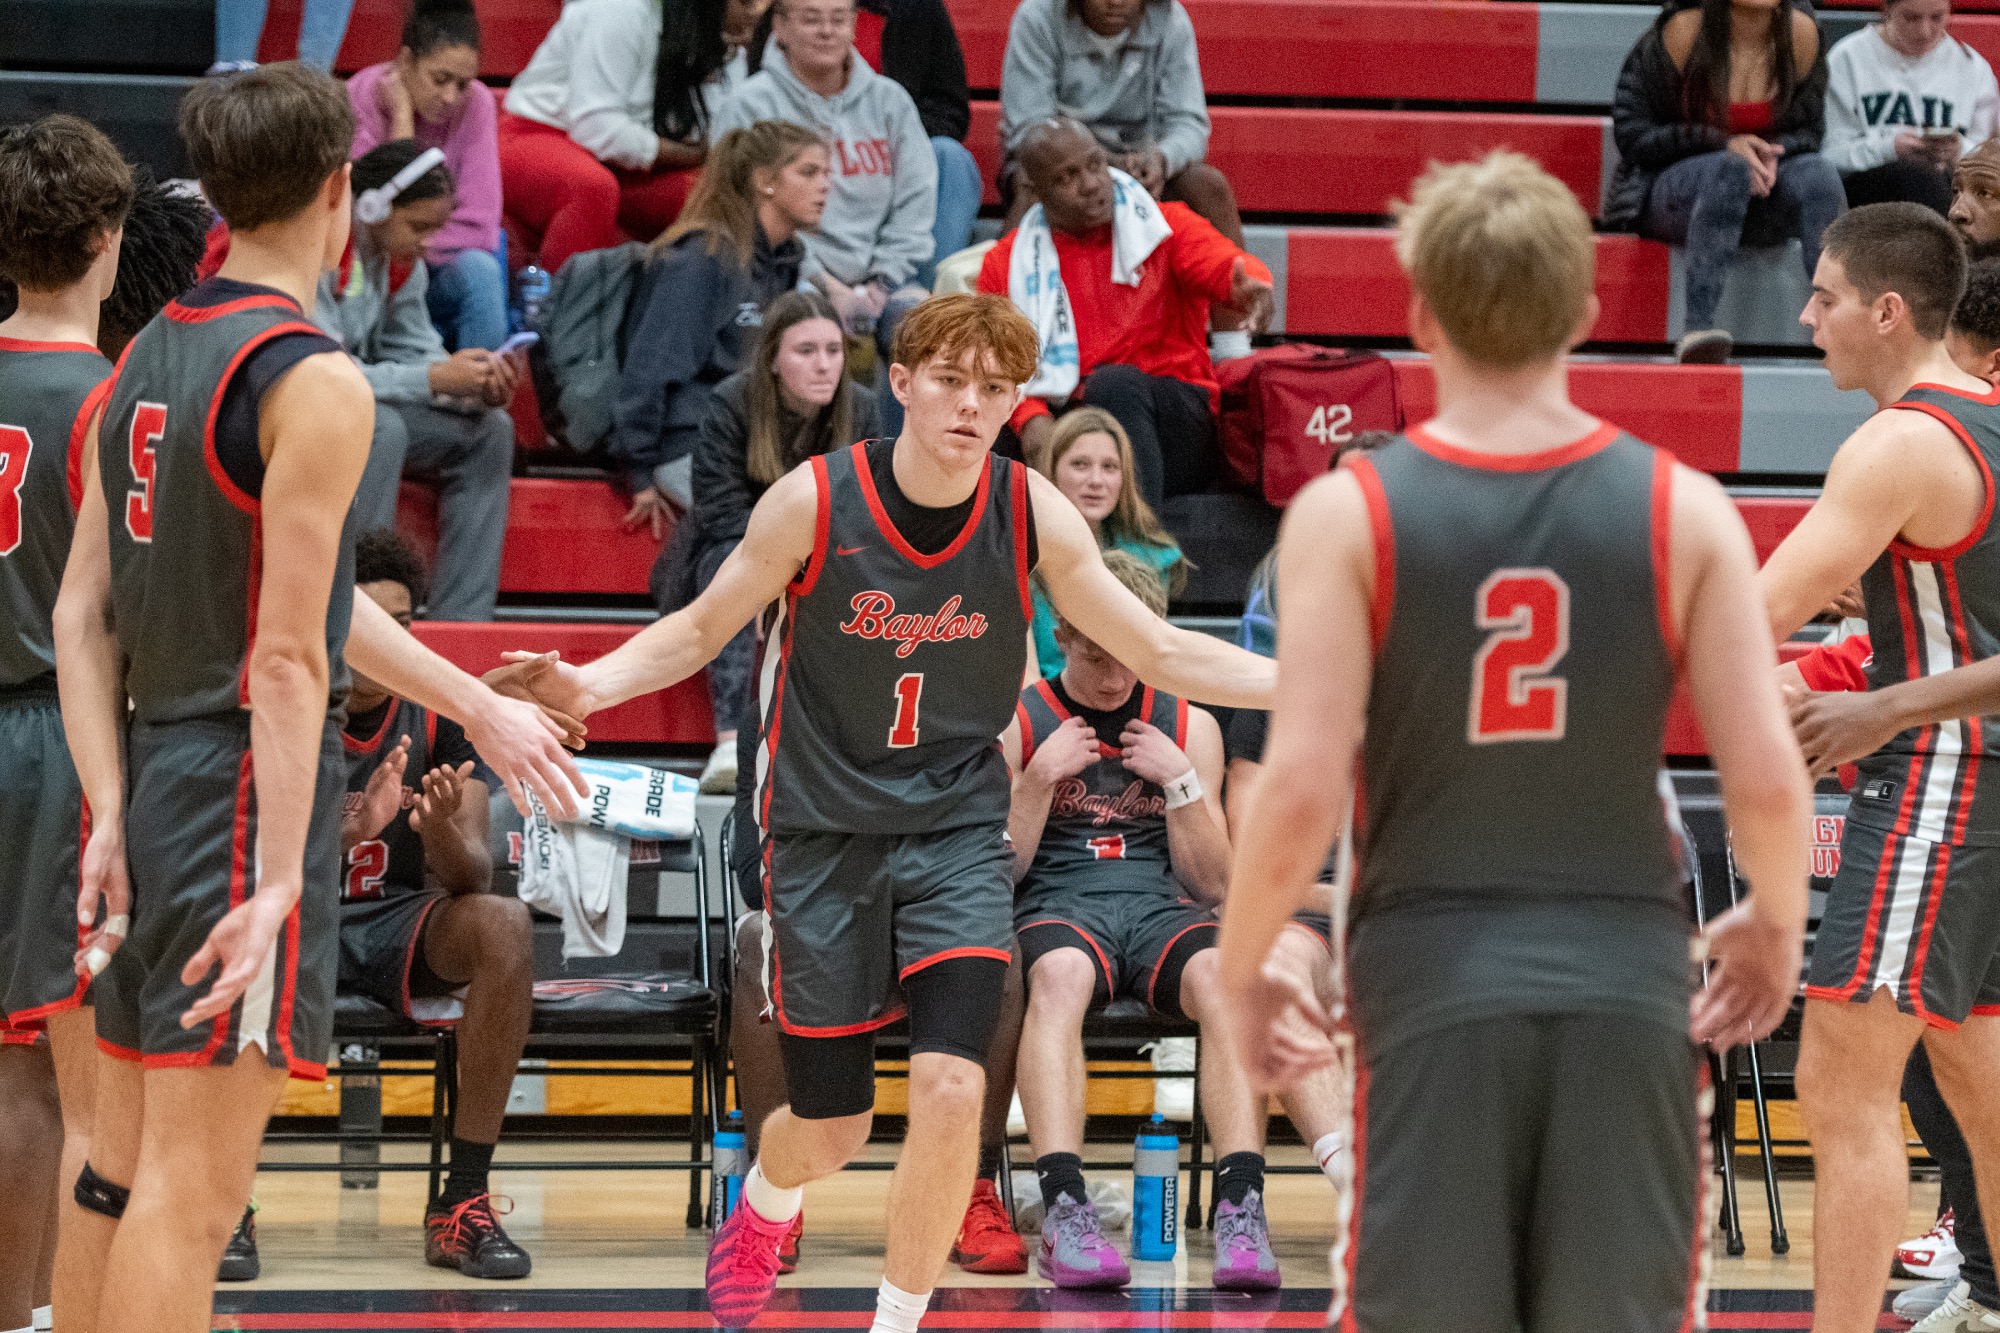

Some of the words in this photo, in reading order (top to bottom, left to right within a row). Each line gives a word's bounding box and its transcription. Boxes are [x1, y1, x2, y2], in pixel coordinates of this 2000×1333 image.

[1304, 404, 1352, 444] 42
[125, 401, 168, 543] 5
[840, 590, 988, 659] Baylor
[1468, 567, 1570, 744] 2
[887, 672, 924, 748] 1
[1050, 777, 1165, 825] Baylor
[340, 839, 389, 898] 2
